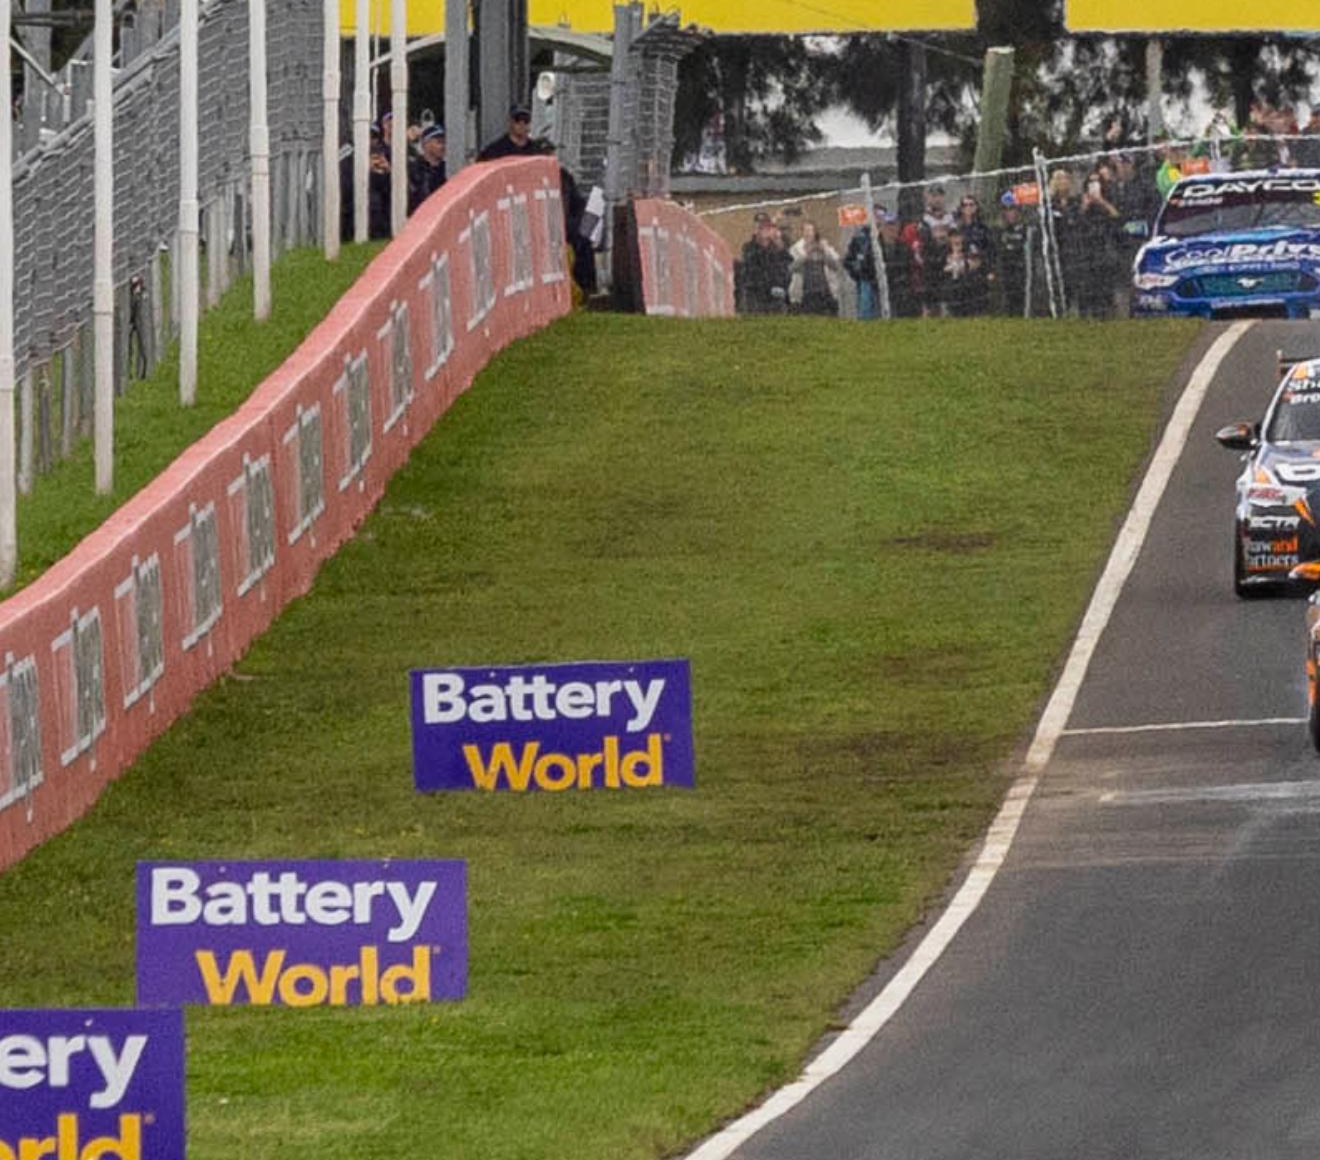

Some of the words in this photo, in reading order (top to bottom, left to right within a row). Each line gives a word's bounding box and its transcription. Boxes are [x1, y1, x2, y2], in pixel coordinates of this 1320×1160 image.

[422, 672, 666, 732] Battery
[463, 733, 664, 790] World
[150, 867, 438, 942] Battery
[195, 944, 432, 1006] World
